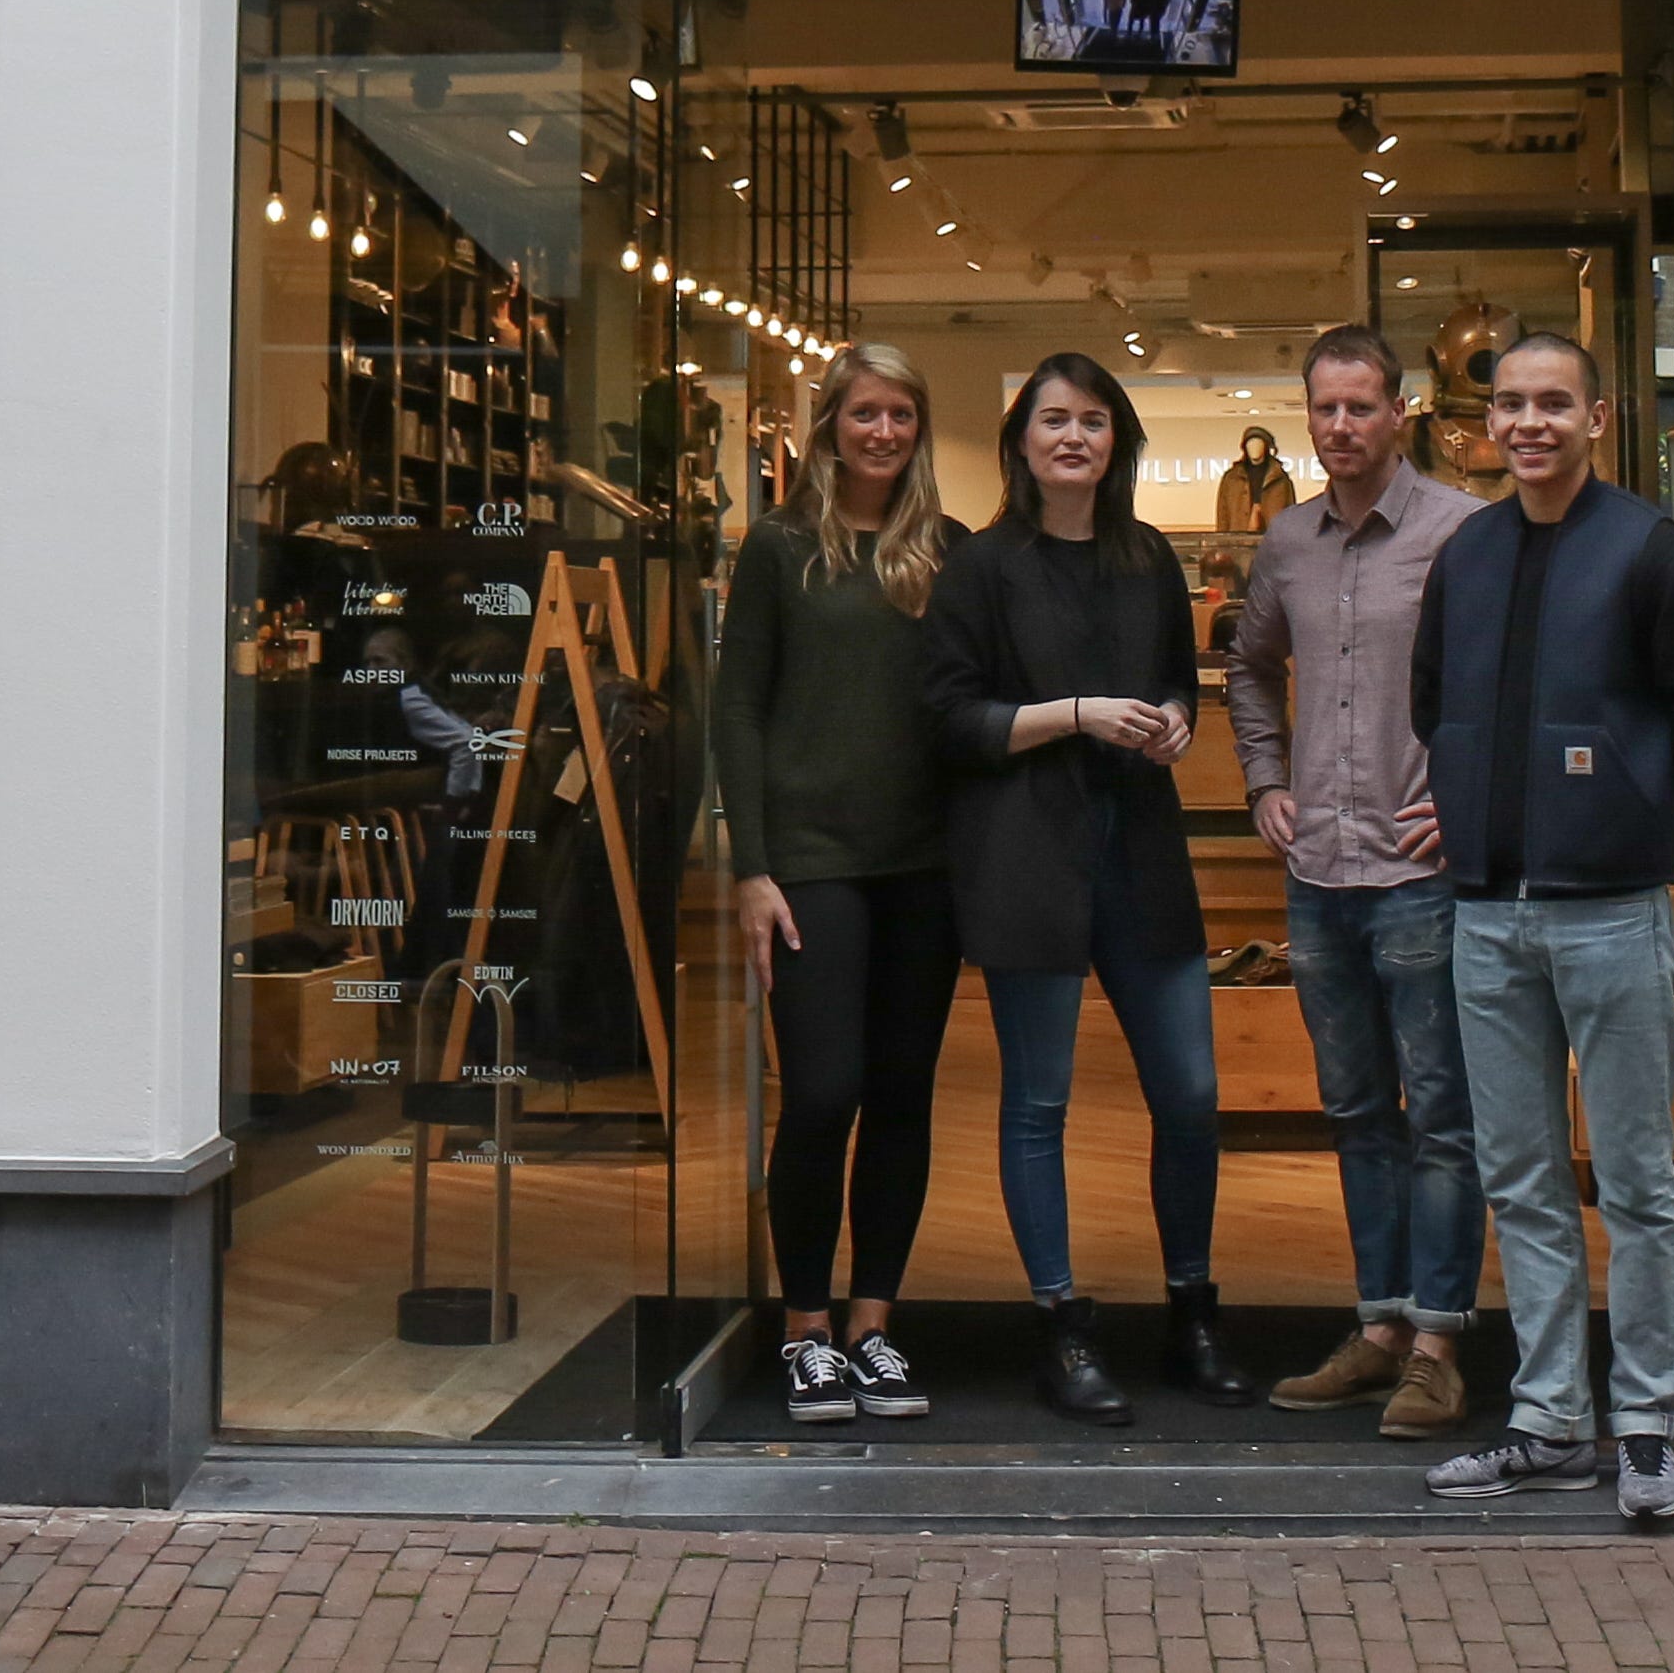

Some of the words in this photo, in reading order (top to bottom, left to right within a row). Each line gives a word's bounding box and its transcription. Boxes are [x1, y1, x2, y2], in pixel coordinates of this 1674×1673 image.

[1138, 456, 1229, 483] ILLIN
[1279, 456, 1330, 482] PIE
[336, 515, 375, 526] WOOD
[378, 515, 417, 526] WOOD
[476, 502, 523, 527] C.P.
[472, 526, 526, 537] COMPANY
[483, 583, 508, 594] THE
[463, 593, 508, 605] NORTH
[476, 605, 508, 616] FACE
[342, 669, 405, 684] ASPESI
[450, 673, 495, 684] MAISON
[327, 749, 362, 760] NORSE
[364, 750, 417, 761] PROJECTS
[449, 826, 492, 839] FILLING
[497, 830, 536, 843] PIECES
[332, 899, 404, 926] DRYKORN
[474, 966, 514, 980] EDWIN
[336, 985, 399, 999] CLOSED
[461, 1065, 527, 1077] FILSON
[316, 1145, 347, 1156] WON
[350, 1146, 411, 1156] HUNDRED
